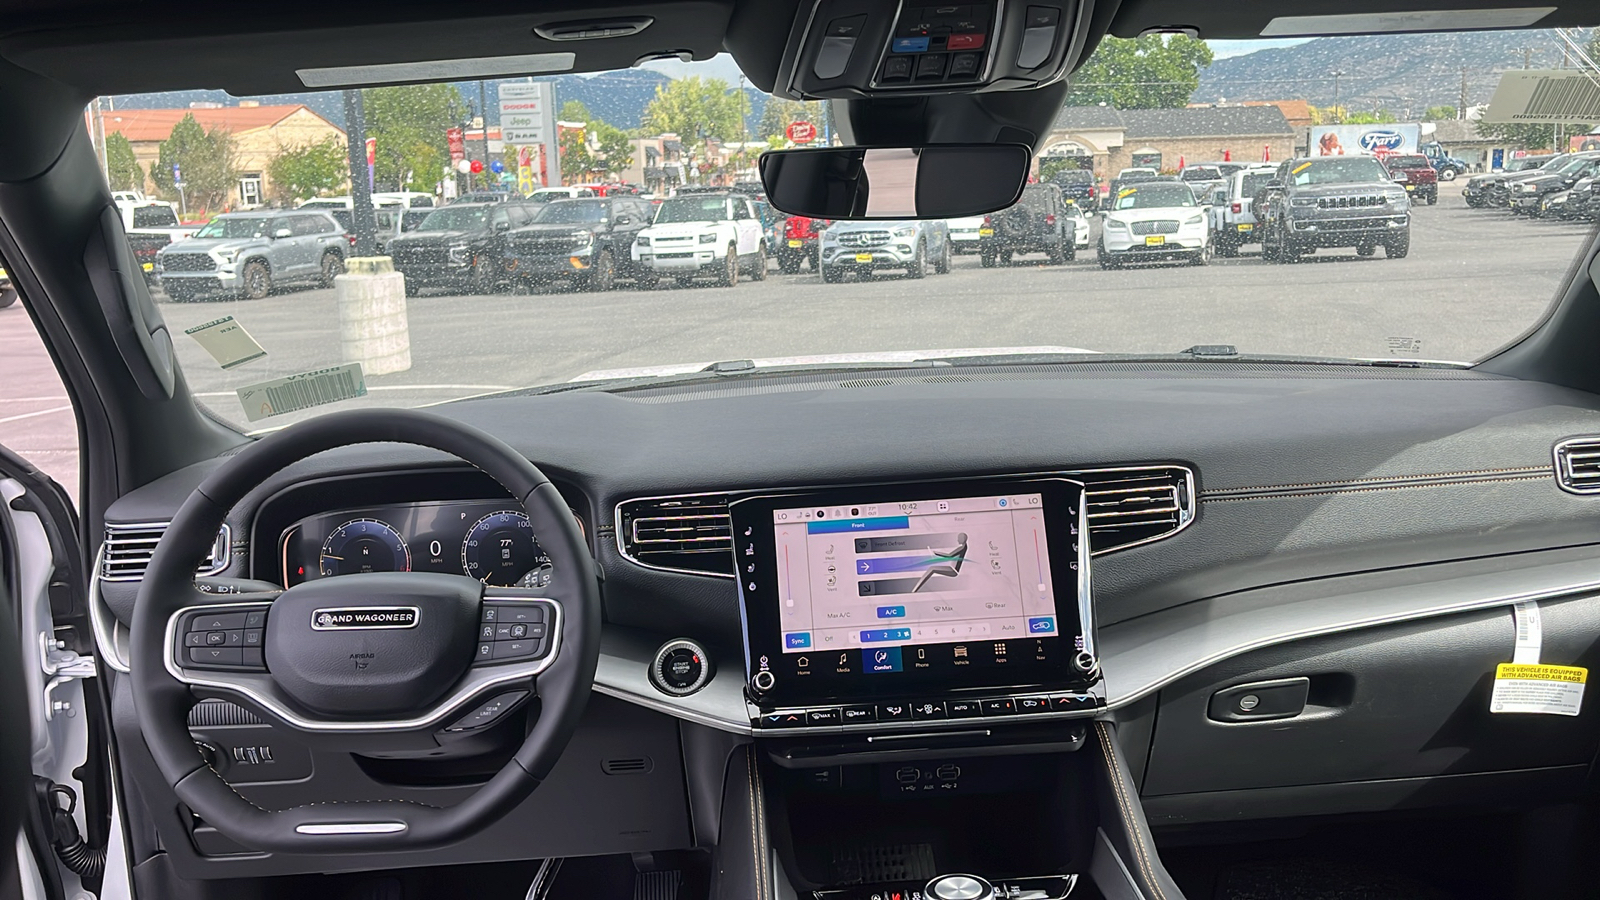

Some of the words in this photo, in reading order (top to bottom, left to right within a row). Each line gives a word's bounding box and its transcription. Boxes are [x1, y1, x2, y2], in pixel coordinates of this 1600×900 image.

[510, 117, 531, 126] Jeep
[1364, 131, 1399, 150] Farr
[480, 523, 489, 531] 60
[429, 540, 441, 556] 0
[318, 614, 353, 624] GRAND
[354, 613, 413, 622] WAGONEER
[1549, 668, 1582, 677] EQUIPPED
